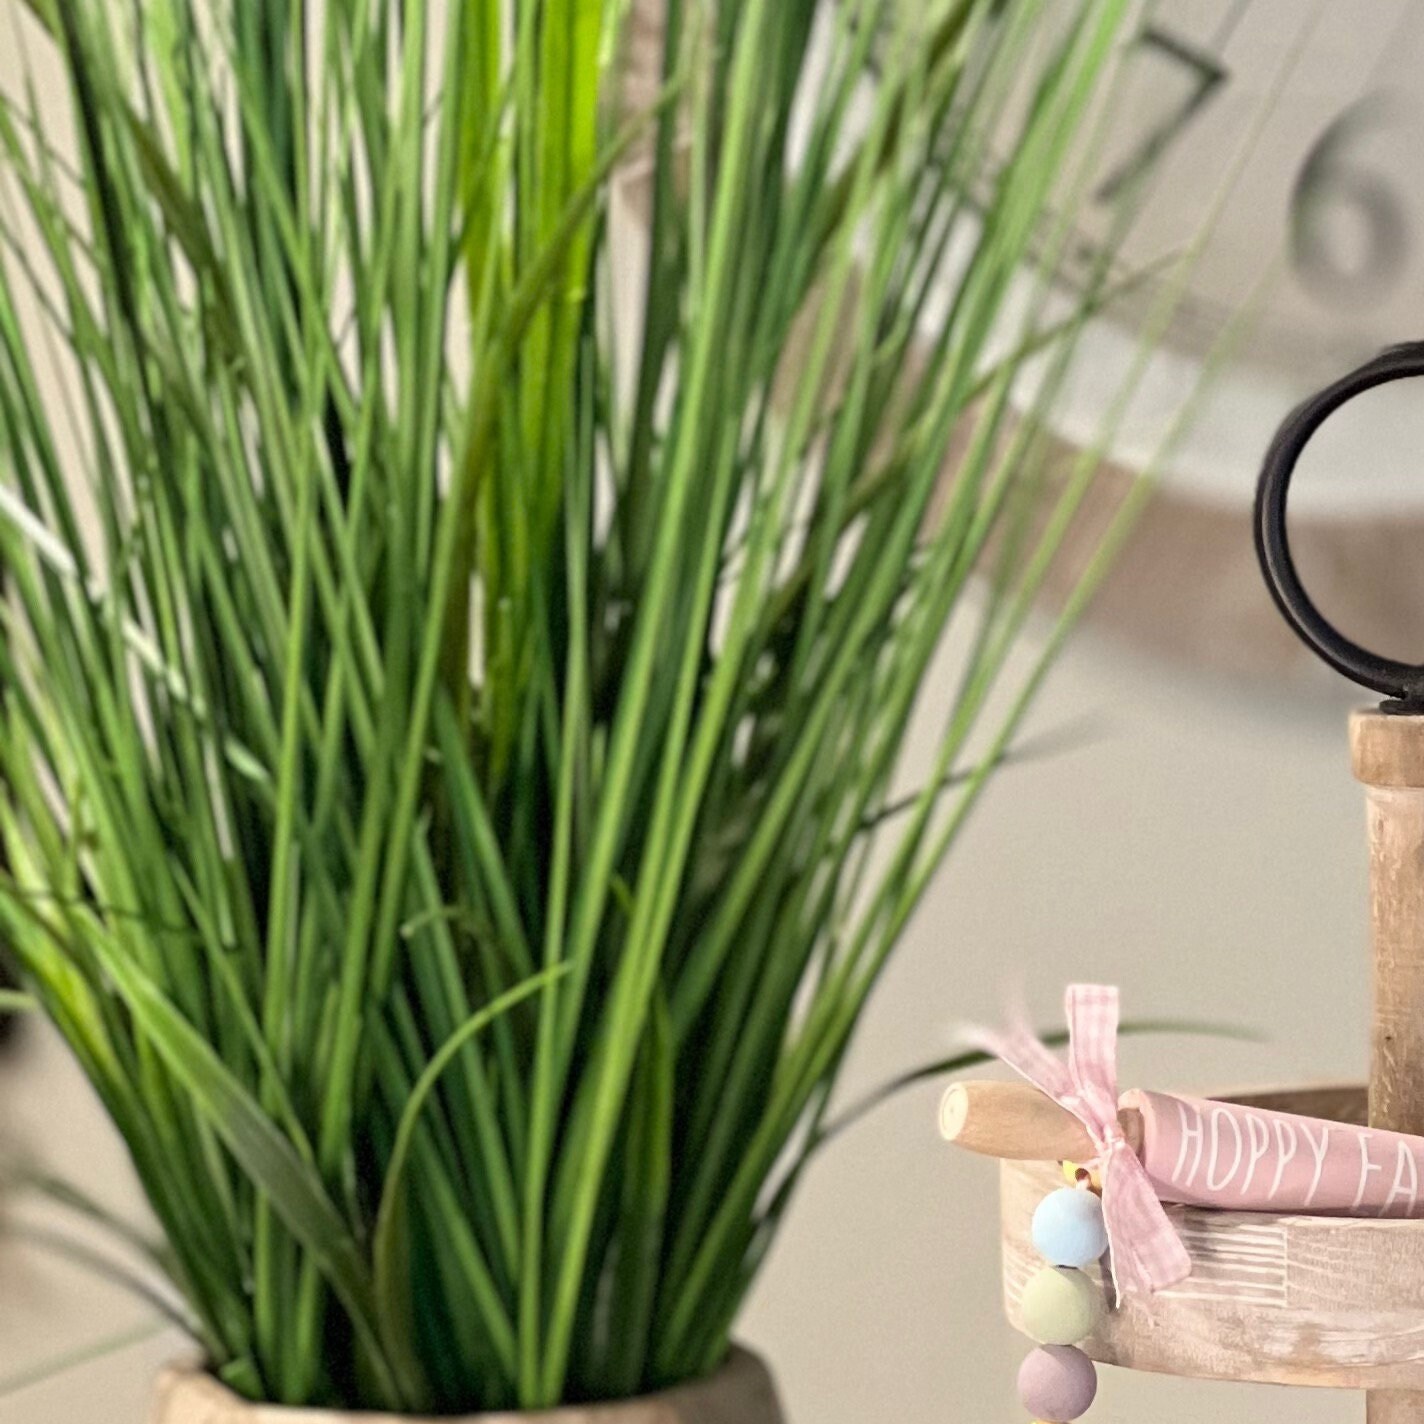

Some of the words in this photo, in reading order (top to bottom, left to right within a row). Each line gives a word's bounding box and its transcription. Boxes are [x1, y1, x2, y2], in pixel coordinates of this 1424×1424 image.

[1092, 24, 1233, 206] 7
[1287, 90, 1410, 308] 6
[1170, 1103, 1329, 1210] HOPPY
